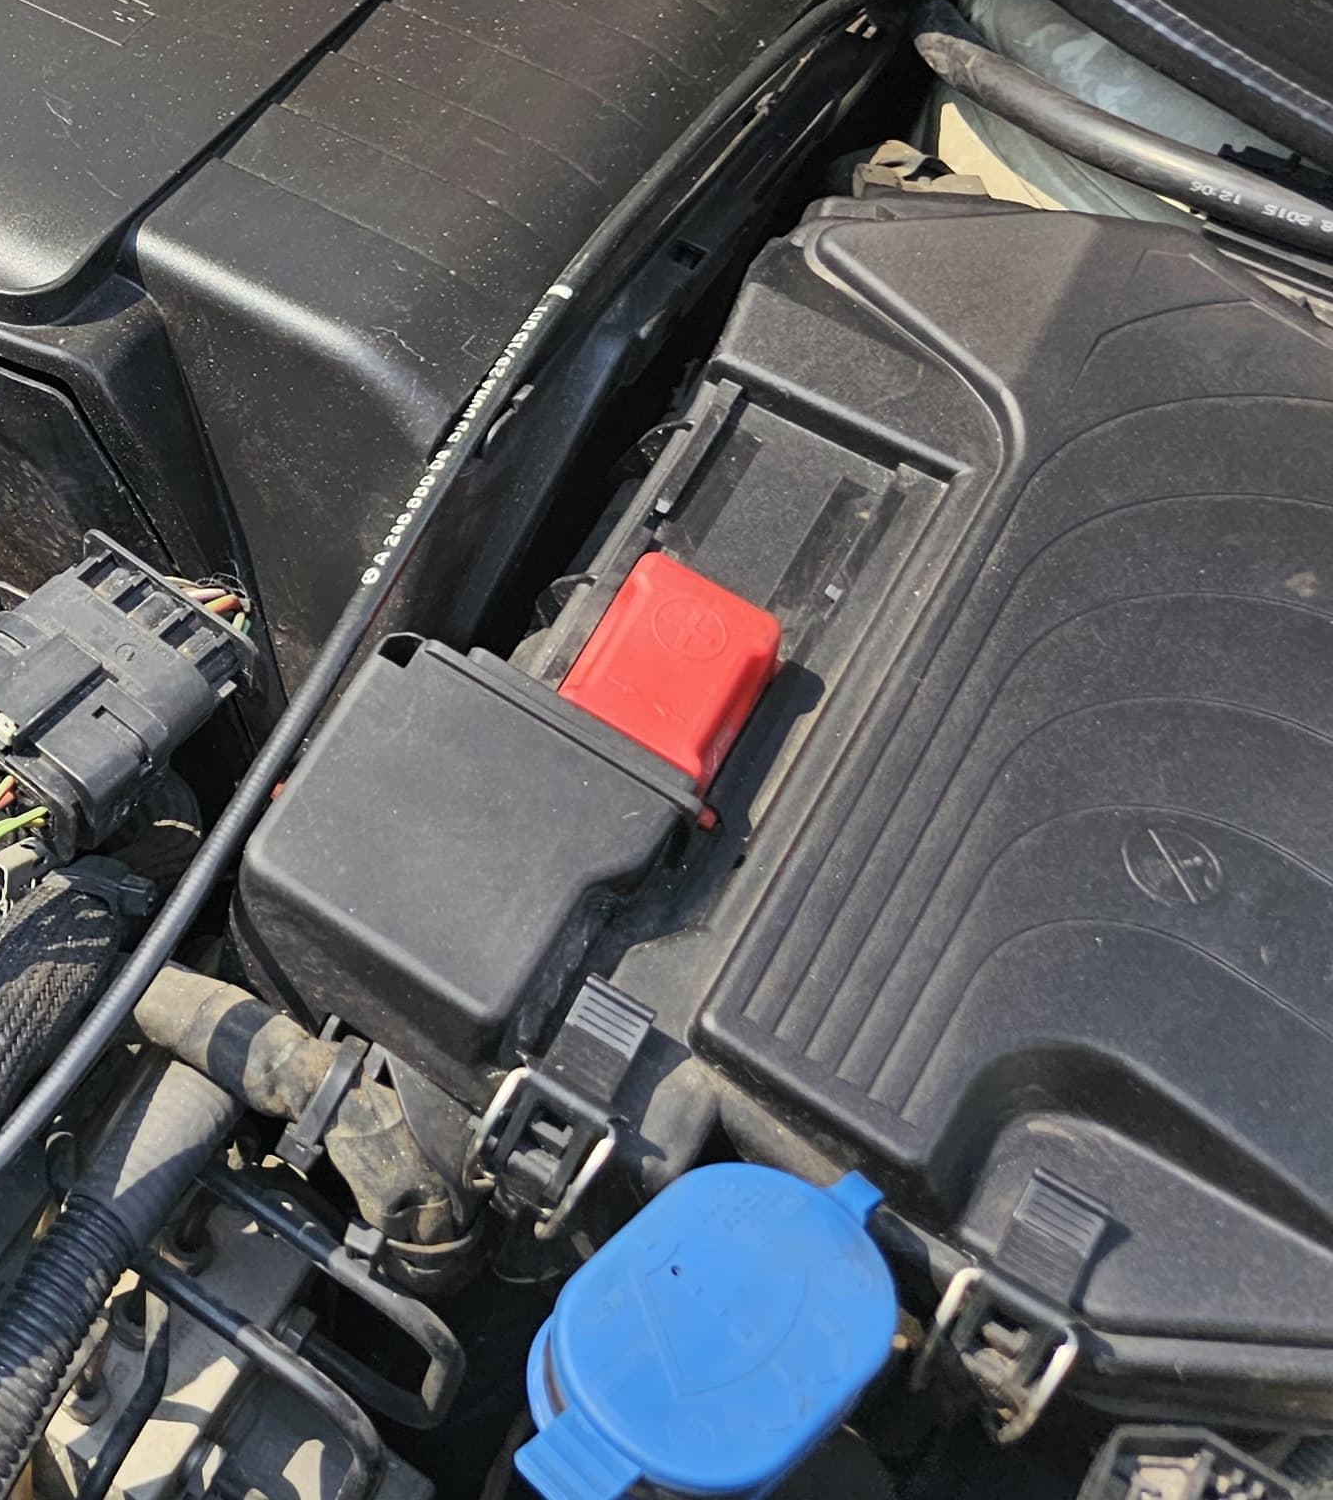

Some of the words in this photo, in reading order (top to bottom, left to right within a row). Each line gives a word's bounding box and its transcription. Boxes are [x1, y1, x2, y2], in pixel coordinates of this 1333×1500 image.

[1189, 180, 1242, 205] 12:06
[1261, 203, 1313, 226] 2015
[373, 552, 390, 566] A
